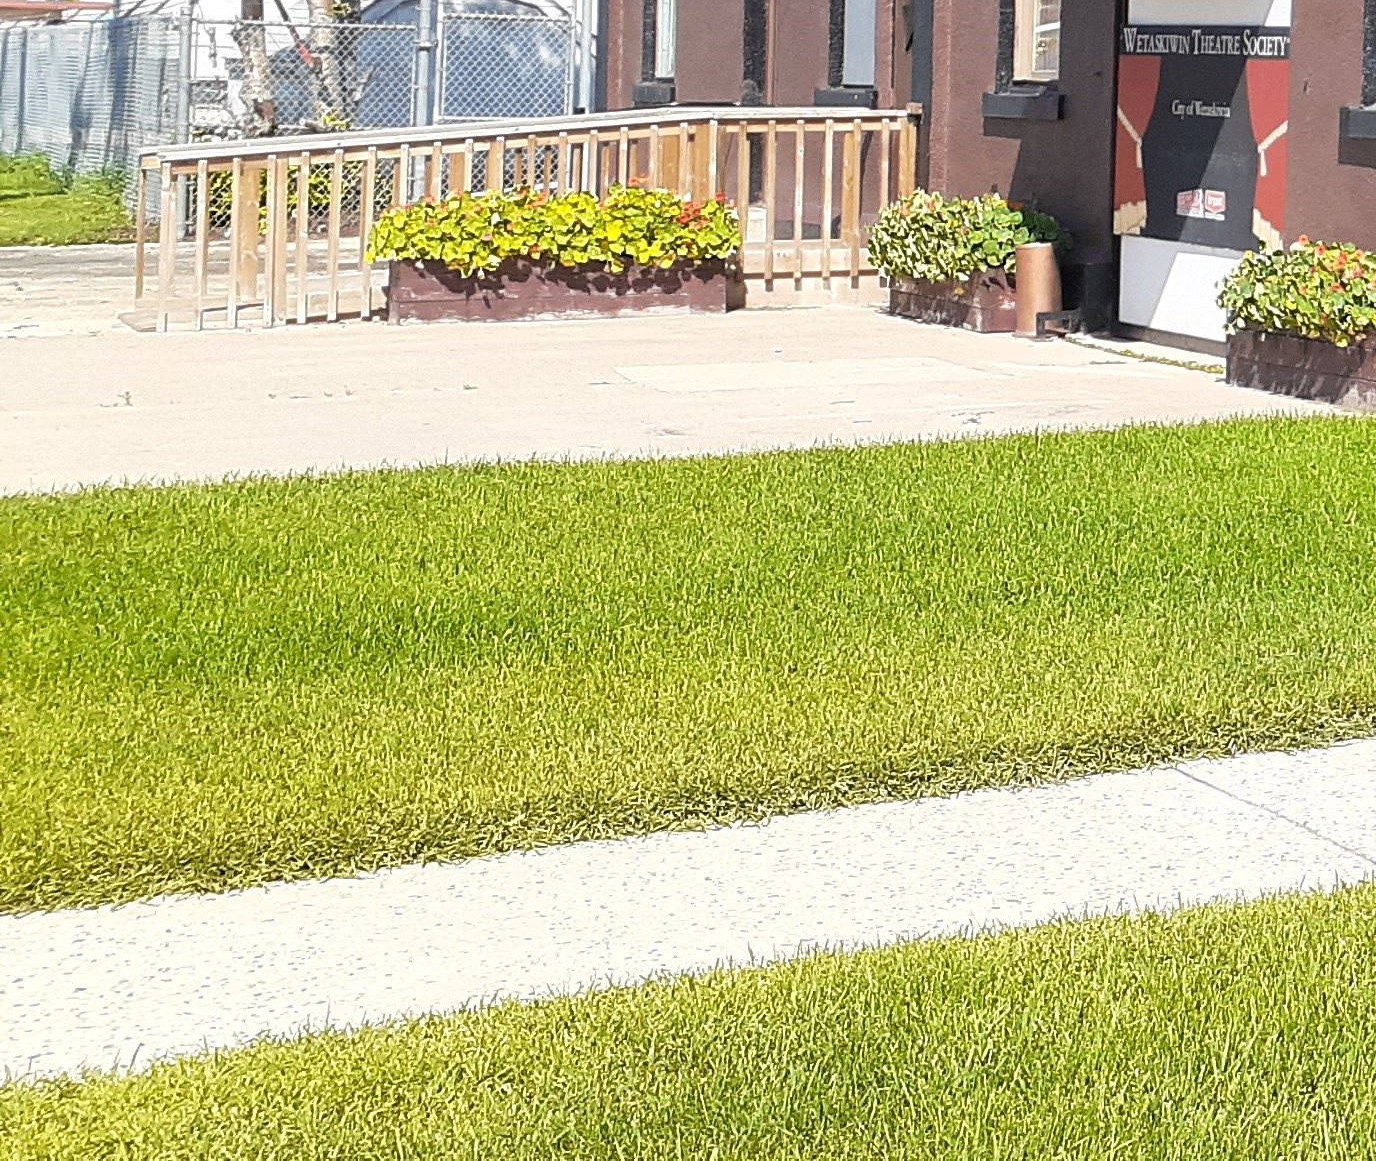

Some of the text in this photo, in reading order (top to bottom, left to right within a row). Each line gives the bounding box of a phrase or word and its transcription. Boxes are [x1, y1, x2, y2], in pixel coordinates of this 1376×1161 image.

[1123, 27, 1286, 56] WETASKIWIN THEATRE SOCIETY
